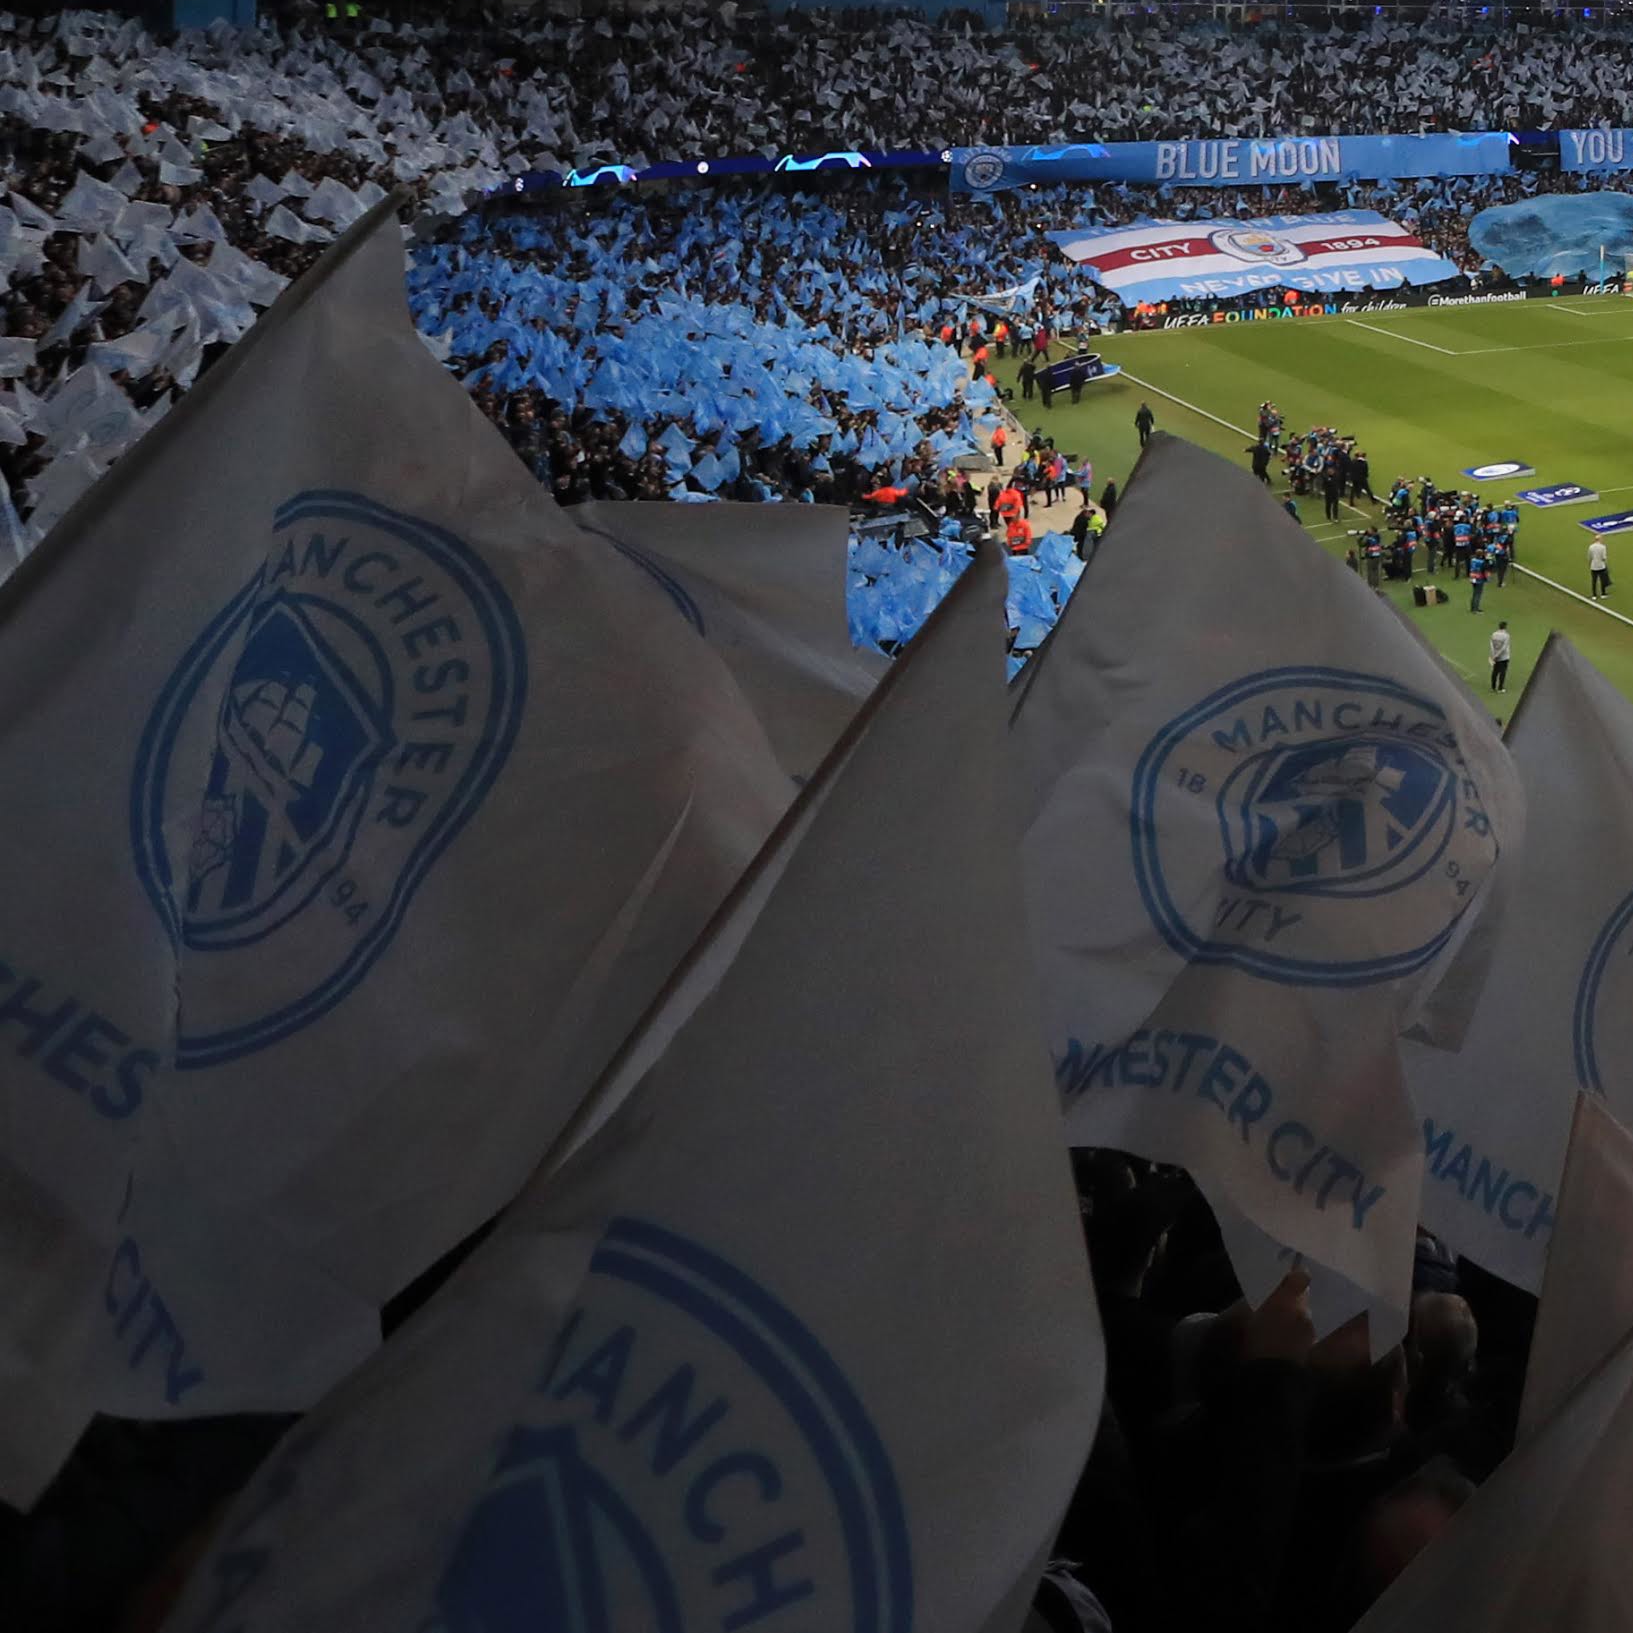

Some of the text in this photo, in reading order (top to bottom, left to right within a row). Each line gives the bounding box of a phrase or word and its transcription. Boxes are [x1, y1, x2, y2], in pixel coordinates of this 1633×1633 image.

[1156, 139, 1342, 180] BLUE MOON
[1571, 130, 1623, 164] YOU
[1130, 236, 1381, 262] CITY 1894
[1368, 266, 1405, 284] IN
[1582, 282, 1619, 295] UEFA
[1164, 299, 1408, 329] UEFA FOUNDATION for children
[1440, 290, 1526, 306] Morethanfootball
[1175, 768, 1471, 898] 18 94
[332, 877, 372, 929] 94
[1265, 1120, 1387, 1232] CITY
[1422, 1116, 1556, 1239] MANCH
